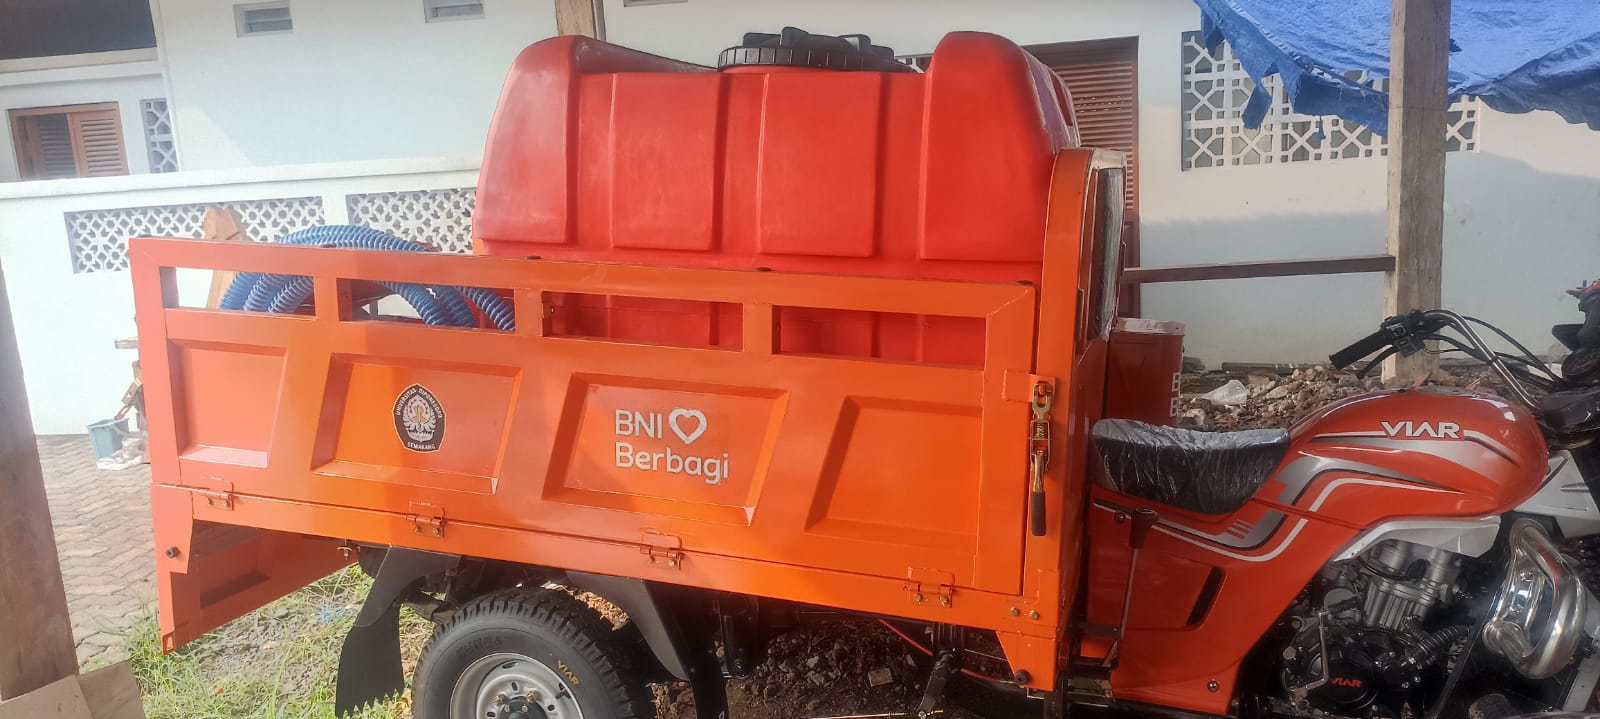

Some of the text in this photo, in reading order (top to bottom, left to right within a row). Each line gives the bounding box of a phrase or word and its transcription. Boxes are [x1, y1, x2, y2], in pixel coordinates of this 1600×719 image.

[615, 409, 663, 439] BNI
[1380, 421, 1461, 439] VIAR
[615, 441, 729, 485] Berbagi
[557, 659, 580, 686] VIAR
[1330, 677, 1362, 688] VIAR
